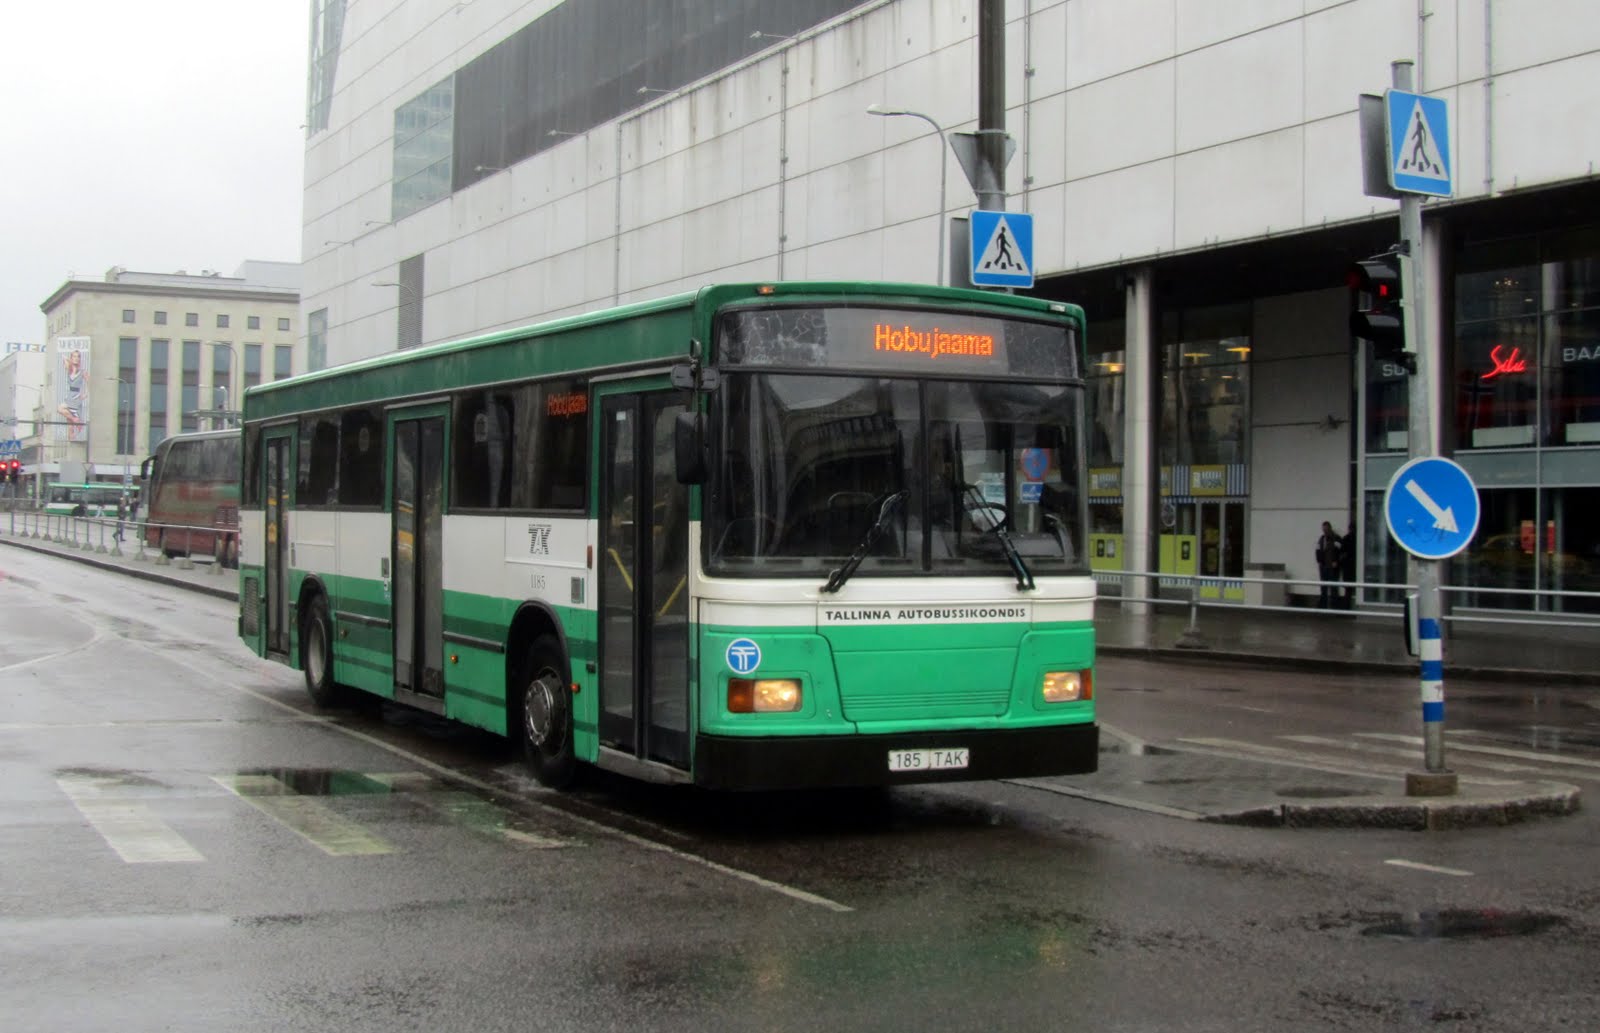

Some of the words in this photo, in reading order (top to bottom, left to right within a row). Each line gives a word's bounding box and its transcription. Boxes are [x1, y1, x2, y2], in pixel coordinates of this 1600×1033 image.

[874, 323, 994, 359] Hobujaama
[825, 609, 892, 621] TALLINNA
[897, 607, 1026, 620] AUTOBUSSIKOONDIS
[896, 752, 921, 769] 185
[934, 751, 965, 767] TAK
